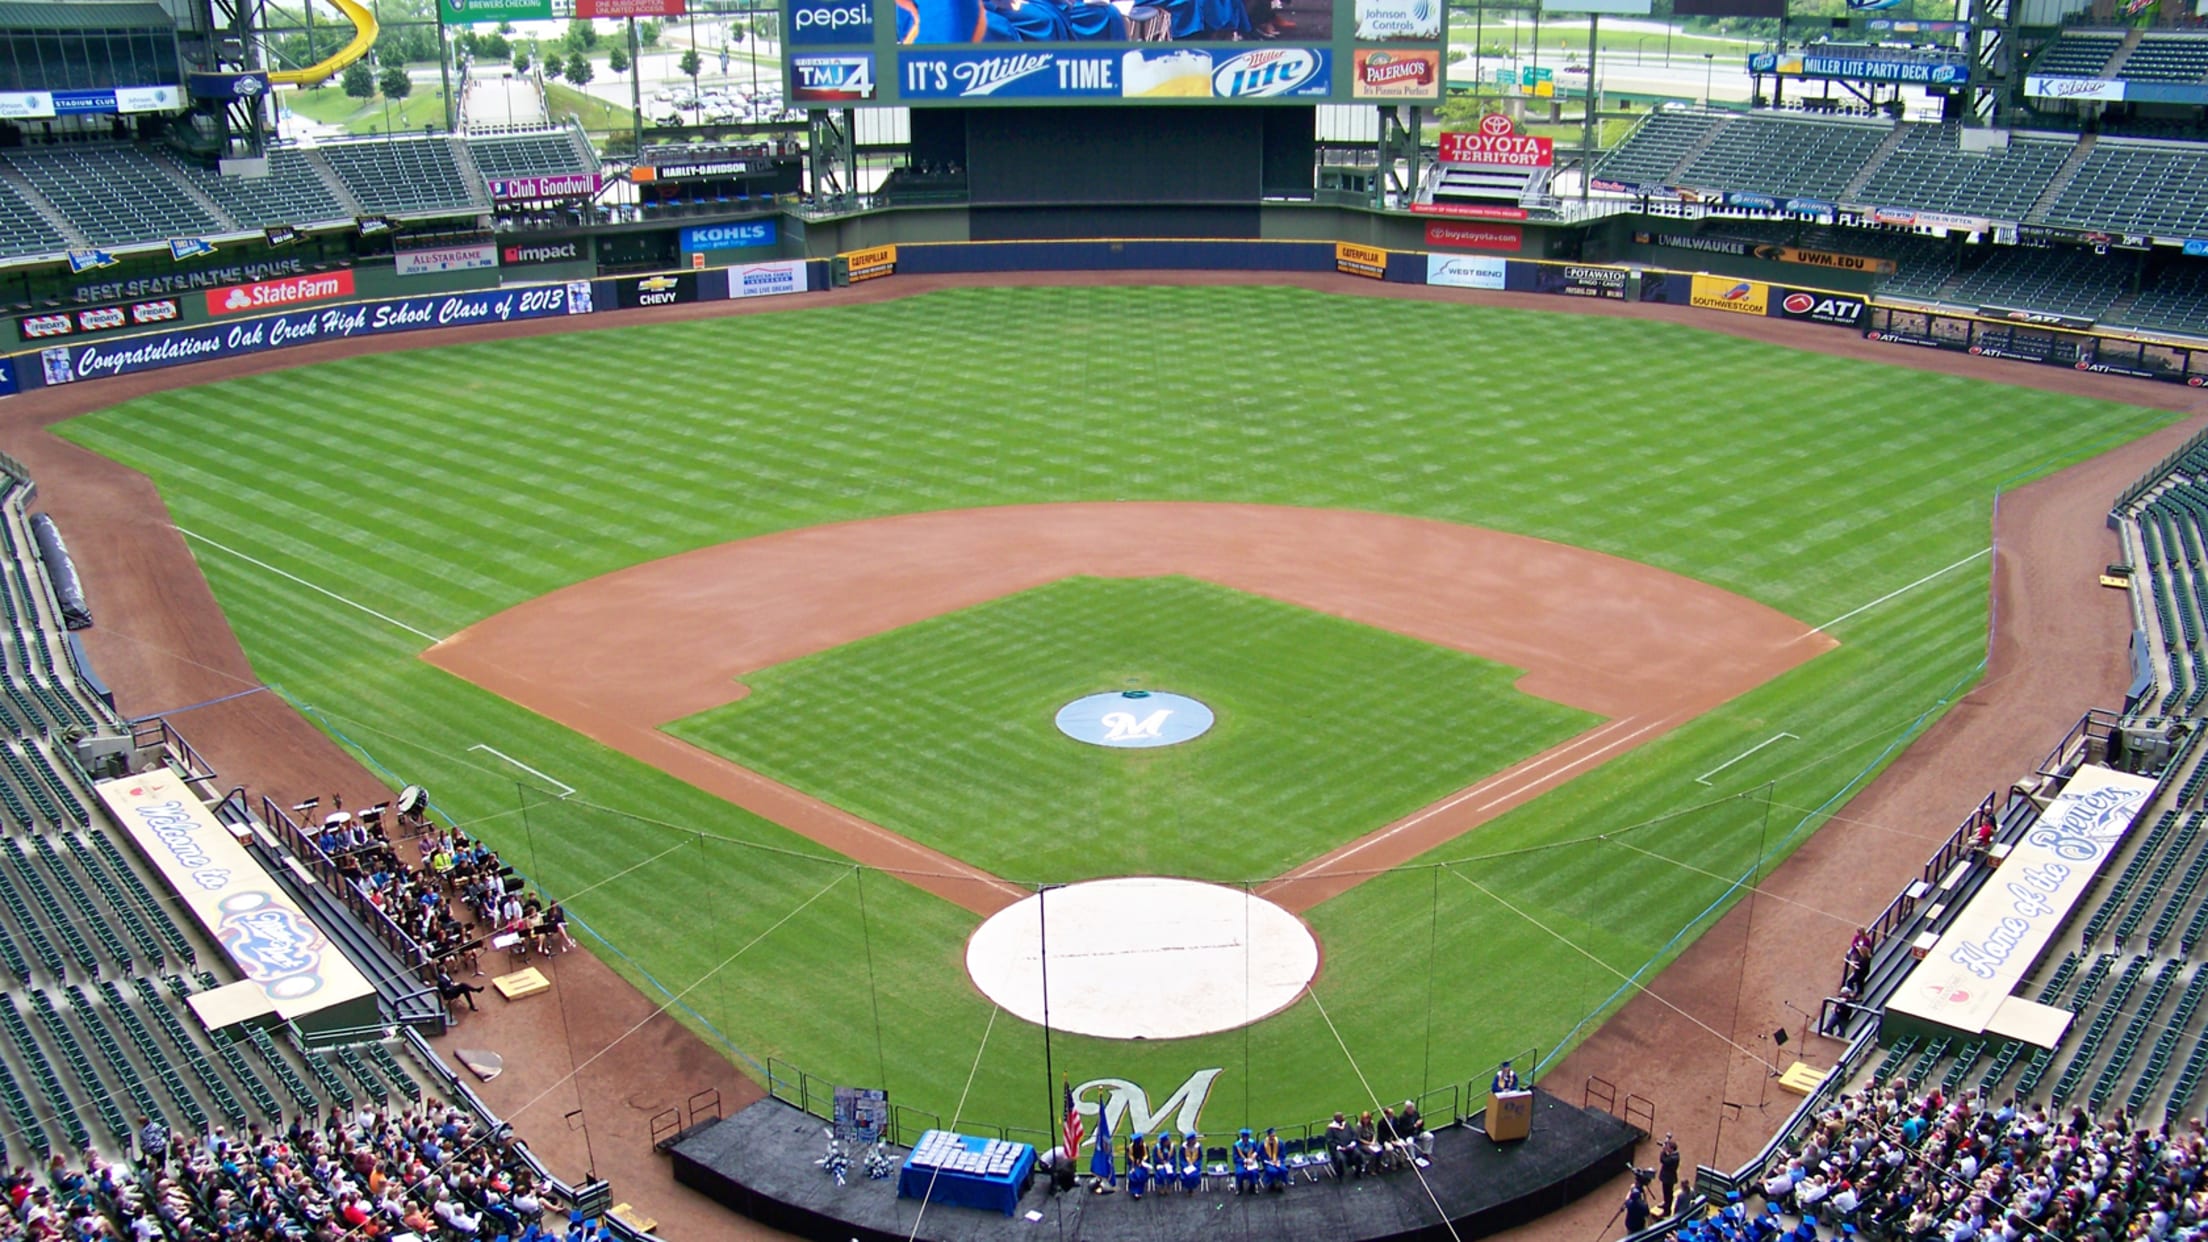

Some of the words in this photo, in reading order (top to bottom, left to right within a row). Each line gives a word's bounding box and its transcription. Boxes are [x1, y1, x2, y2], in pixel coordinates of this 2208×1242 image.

[795, 3, 867, 31] pepsi
[1366, 9, 1407, 19] Johnson
[1372, 20, 1414, 30] Controls
[1244, 50, 1286, 67] Miller
[799, 66, 843, 85] TMJ
[840, 57, 874, 98] 4
[908, 60, 947, 91] IT'S
[953, 53, 1053, 96] Miller
[1230, 58, 1304, 96] Lite
[1367, 62, 1425, 82] PALERMO'S
[1804, 58, 1840, 75] MILLER
[1843, 61, 1863, 76] LITE
[1865, 61, 1899, 79] PARTY
[1901, 64, 1929, 80] DECK
[56, 99, 93, 107] STADIUM
[1453, 134, 1539, 153] TOYOTA
[1452, 150, 1539, 165] TERRITORY
[662, 162, 746, 178] HARLEY-DAVIDSON
[509, 178, 535, 199] Club
[540, 175, 594, 196] Goodwill
[692, 225, 766, 242] KOHL'S
[1445, 229, 1517, 242] buyatoyota.com
[518, 242, 576, 262] impact
[1798, 251, 1864, 268] UWM.EDU
[1450, 268, 1475, 277] WEST
[1476, 269, 1502, 279] BEND
[640, 292, 676, 306] CHEVY
[1692, 296, 1763, 313] SOUTHWEST.COM
[142, 305, 171, 317] FRIDAYS
[1813, 299, 1863, 318] ATI
[35, 320, 67, 332] FRIDAYS
[89, 312, 119, 324] FRIDAYS
[78, 336, 220, 377] Congratulations
[227, 323, 263, 348] Oak
[269, 314, 317, 345] Creek
[321, 306, 367, 336] High
[372, 302, 433, 328] School
[438, 297, 488, 324] Class
[494, 294, 513, 320] of
[519, 288, 564, 312] 2013
[1879, 333, 1899, 342] ATI
[1981, 348, 2001, 357] ATI
[2088, 363, 2110, 373] ATI
[1101, 709, 1174, 742] M
[2028, 785, 2144, 861] Brewers
[136, 800, 211, 869] Welcome
[192, 867, 231, 890] to
[2024, 862, 2070, 893] the
[2007, 882, 2054, 918] of
[1951, 916, 2029, 979] Home
